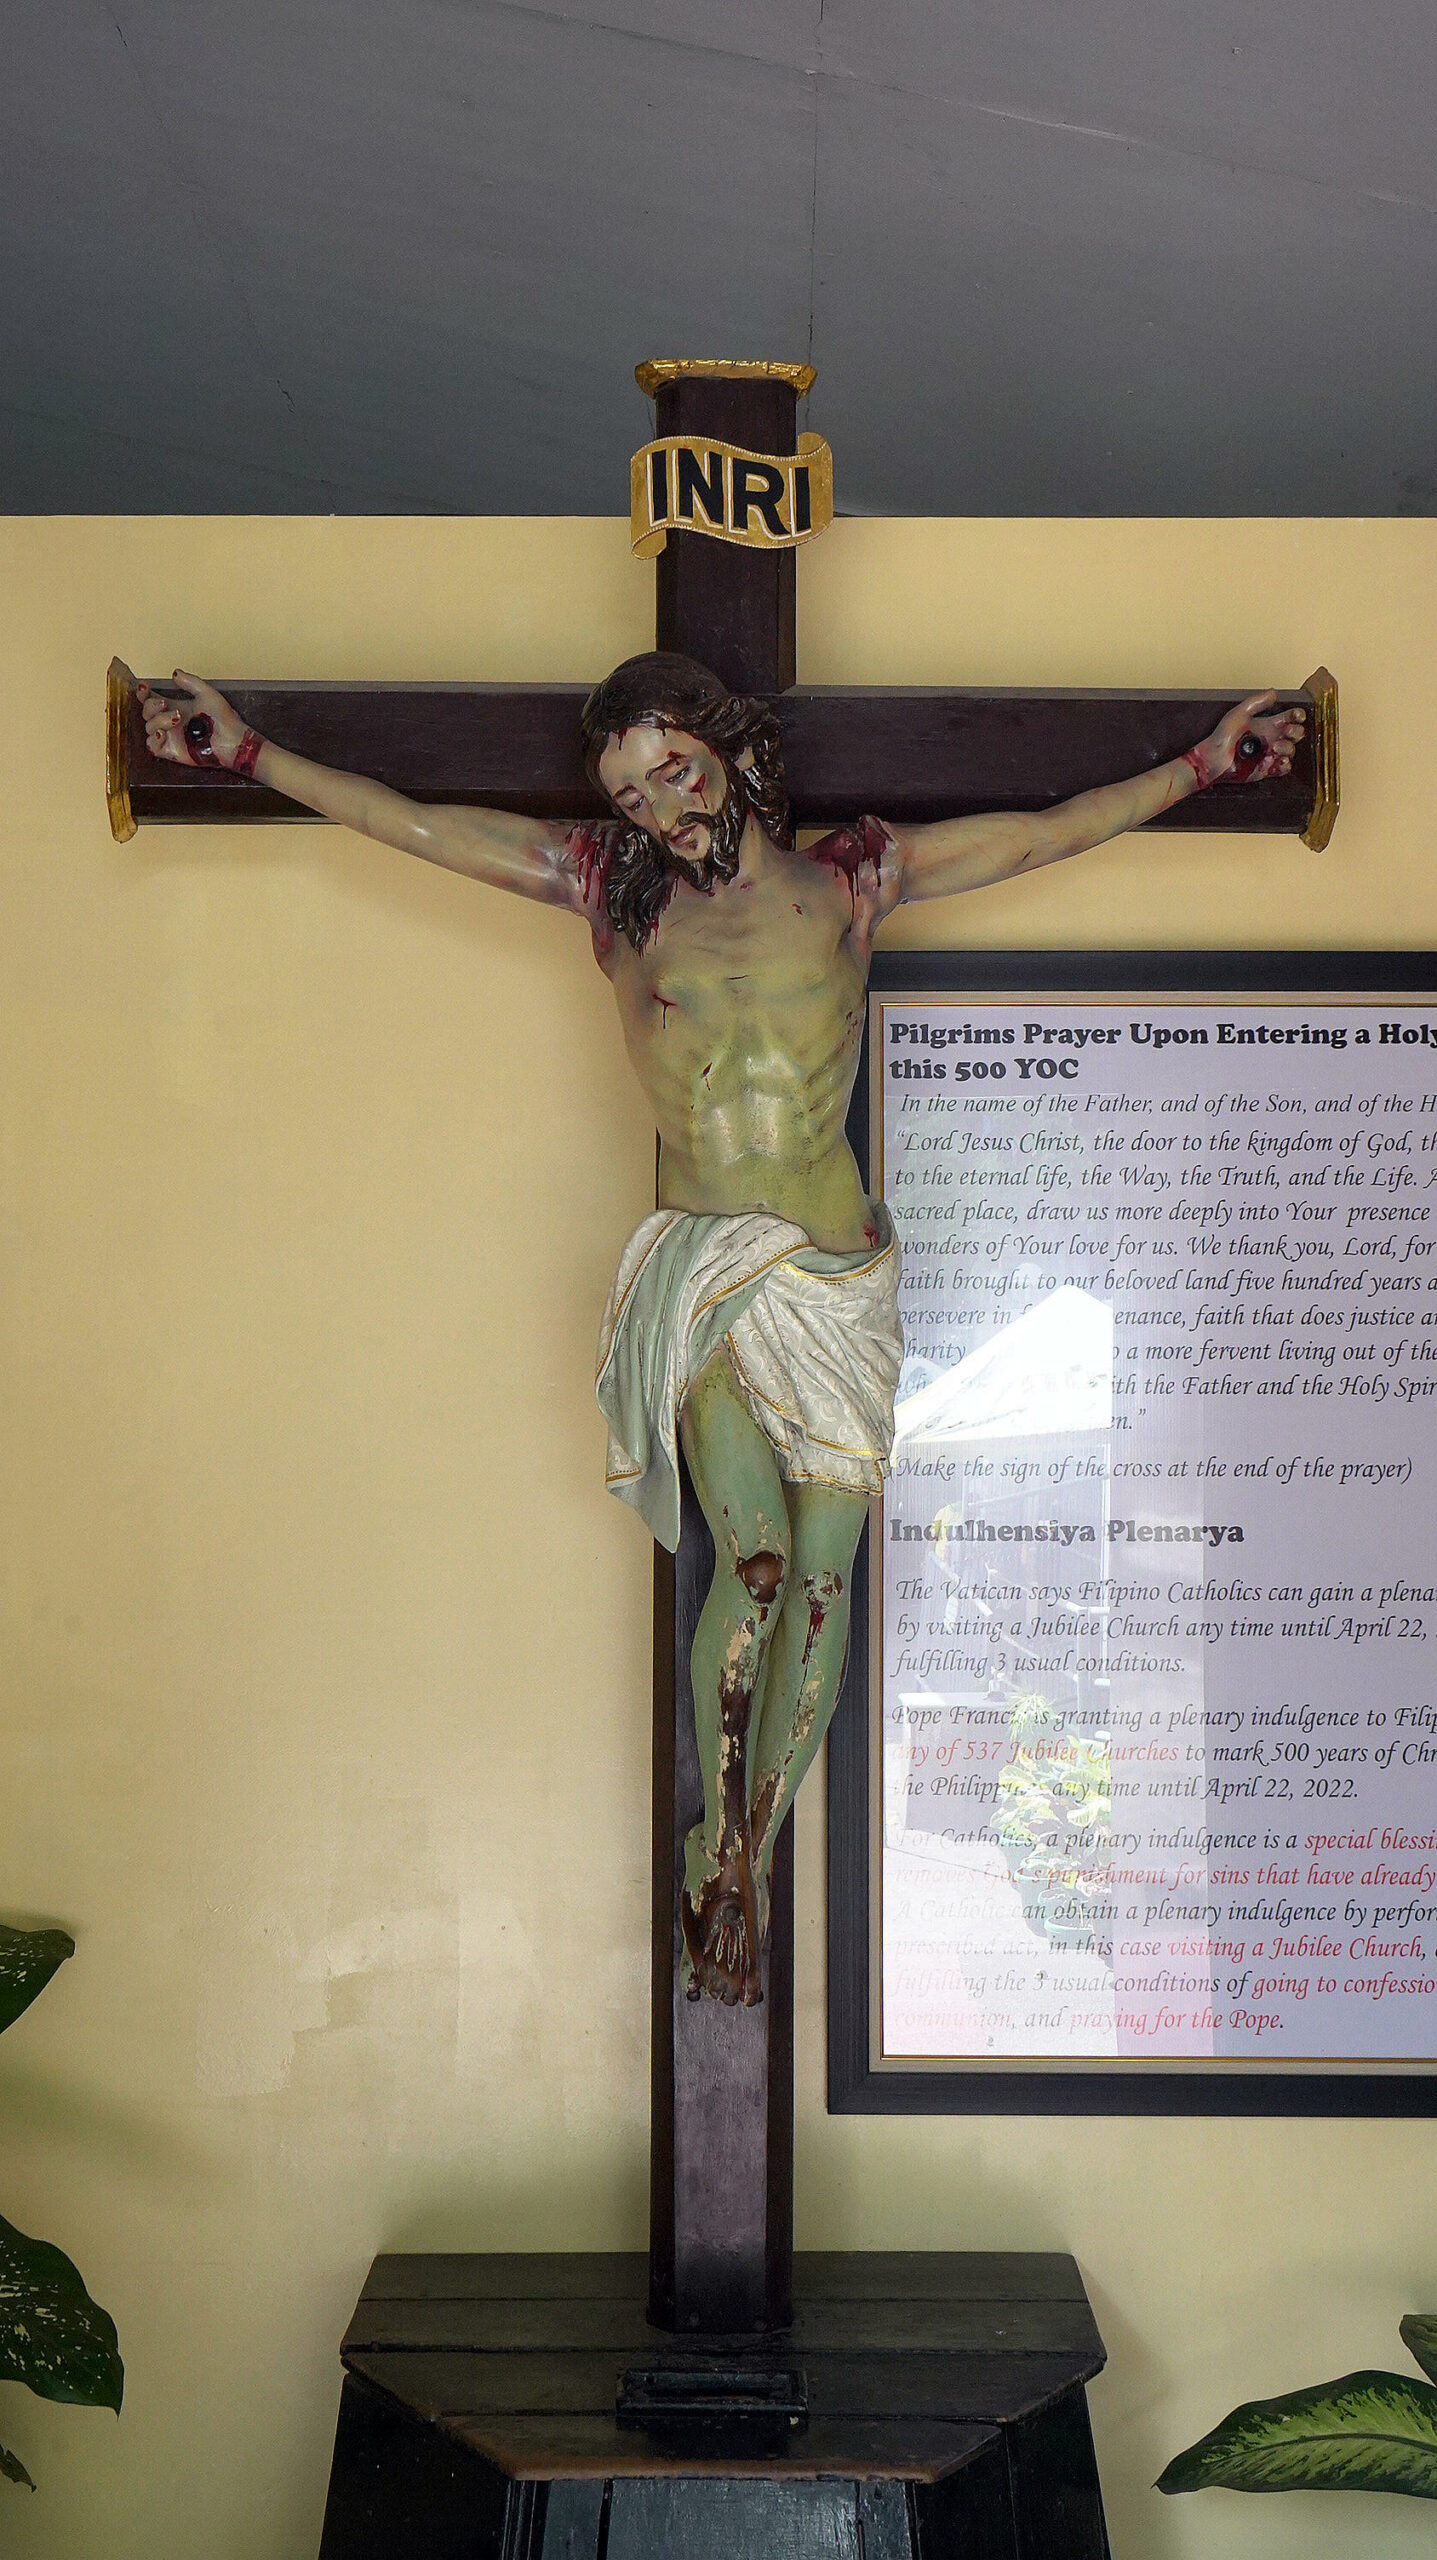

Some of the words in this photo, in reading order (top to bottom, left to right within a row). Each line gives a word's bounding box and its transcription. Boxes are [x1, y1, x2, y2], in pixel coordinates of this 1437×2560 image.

[647, 448, 812, 540] INRI
[889, 1024, 1015, 1049] Pilgrims
[1023, 1024, 1121, 1048] Prayer
[1129, 1024, 1209, 1048] Upon
[1216, 1024, 1347, 1049] Entering
[1355, 1028, 1371, 1044] a
[889, 1059, 947, 1079] this
[955, 1062, 1007, 1081] 500
[1014, 1058, 1079, 1079] YOC
[901, 1094, 920, 1112] In
[927, 1094, 957, 1112] the
[964, 1099, 1017, 1112] name
[1049, 1094, 1078, 1112] the
[1084, 1094, 1153, 1115] Father,
[1161, 1094, 1199, 1112] and
[1230, 1094, 1260, 1112] the
[1266, 1094, 1307, 1114] Son,
[1315, 1094, 1353, 1112] and
[1383, 1094, 1413, 1112] the
[958, 1132, 1013, 1154] Jesus
[1019, 1130, 1084, 1155] Christ,
[1094, 1130, 1124, 1150] the
[1131, 1130, 1177, 1150] door
[1209, 1130, 1240, 1150] the
[1247, 1130, 1333, 1158] kingdom
[1339, 1130, 1364, 1158] of
[1367, 1131, 1413, 1158] God,
[923, 1165, 953, 1185] the
[959, 1165, 1034, 1185] eternal
[1035, 1165, 1072, 1192] life,
[1081, 1165, 1112, 1185] the
[1119, 1165, 1171, 1192] Way,
[1181, 1165, 1212, 1186] the
[1218, 1165, 1280, 1189] Truth,
[1289, 1165, 1335, 1186] and
[1334, 1165, 1364, 1186] the
[1371, 1165, 1417, 1192] Life.
[894, 1199, 962, 1220] sacred
[962, 1200, 1018, 1226] place,
[1027, 1200, 1080, 1220] draw
[1087, 1205, 1108, 1220] us
[1116, 1205, 1162, 1220] more
[1169, 1200, 1233, 1227] deeply
[1239, 1201, 1279, 1221] into
[1286, 1201, 1337, 1221] Your
[1346, 1206, 1430, 1227] presence
[902, 1234, 986, 1255] wonders
[986, 1234, 1011, 1261] of
[1013, 1237, 1064, 1255] Your
[1069, 1234, 1109, 1255] love
[1110, 1234, 1148, 1261] for
[1187, 1234, 1221, 1255] We
[1229, 1234, 1292, 1259] thank
[1290, 1241, 1334, 1262] you,
[1343, 1234, 1397, 1258] Lord,
[1399, 1235, 1436, 1262] for
[952, 1269, 1030, 1296] brought
[1104, 1269, 1183, 1290] beloved
[1185, 1269, 1235, 1290] land
[1230, 1270, 1274, 1296] five
[1281, 1269, 1369, 1290] hundred
[1368, 1276, 1421, 1297] years
[1189, 1304, 1245, 1331] faith
[1252, 1305, 1294, 1325] that
[1301, 1305, 1344, 1325] does
[1346, 1306, 1414, 1332] justice
[1145, 1346, 1192, 1359] more
[1193, 1339, 1271, 1366] fervent
[1278, 1339, 1335, 1367] living
[1343, 1343, 1375, 1360] out
[1383, 1340, 1409, 1366] of
[1144, 1374, 1175, 1395] the
[1183, 1374, 1253, 1395] Father
[1257, 1374, 1300, 1395] and
[1302, 1374, 1333, 1395] the
[1338, 1375, 1389, 1401] Holy
[964, 1456, 995, 1476] the
[1000, 1457, 1041, 1482] sign
[1048, 1456, 1073, 1483] of
[1075, 1456, 1106, 1476] the
[1113, 1462, 1162, 1476] cross
[1167, 1460, 1188, 1477] at
[1196, 1456, 1227, 1477] the
[1234, 1456, 1273, 1477] end
[1276, 1456, 1302, 1484] of
[1303, 1456, 1334, 1477] the
[1339, 1457, 1412, 1484] prayer)
[890, 1519, 1096, 1546] Indulhensiya
[1106, 1519, 1244, 1547] Plenarya
[896, 1578, 933, 1600] The
[940, 1579, 1021, 1600] Vatican
[1028, 1585, 1071, 1606] says
[1078, 1579, 1160, 1607] Filipino
[1168, 1579, 1262, 1603] Catholics
[1268, 1587, 1302, 1601] can
[1307, 1582, 1354, 1608] gain
[897, 1614, 919, 1636] by
[927, 1616, 1003, 1642] visiting
[1027, 1614, 1099, 1639] Jubilee
[1107, 1615, 1179, 1638] Church
[1186, 1622, 1223, 1643] any
[1230, 1617, 1273, 1637] time
[1281, 1615, 1335, 1637] until
[1334, 1616, 1395, 1643] April
[1397, 1619, 1427, 1640] 22,
[890, 1650, 988, 1678] fulfilling
[1014, 1650, 1073, 1671] usual
[1076, 1650, 1185, 1671] conditions.
[892, 1705, 941, 1731] Pope
[1054, 1705, 1142, 1732] granting
[1167, 1704, 1244, 1732] plenary
[1251, 1704, 1359, 1733] indulgence
[1367, 1709, 1386, 1726] to
[936, 1738, 964, 1766] of
[963, 1742, 1003, 1760] 537
[1007, 1740, 1078, 1764] Jubilee
[1186, 1744, 1205, 1761] to
[1213, 1740, 1269, 1766] mark
[1270, 1743, 1310, 1762] 500
[1313, 1747, 1368, 1768] years
[1374, 1741, 1400, 1769] of
[1097, 1776, 1140, 1796] time
[1148, 1776, 1202, 1797] until
[1203, 1776, 1262, 1804] April
[1264, 1779, 1293, 1801] 22,
[1303, 1779, 1358, 1798] 2022.
[1149, 1827, 1256, 1855] indulgence
[1264, 1829, 1280, 1848] is
[1304, 1828, 1378, 1855] special
[1169, 1863, 1206, 1891] for
[1210, 1865, 1249, 1885] sins
[1257, 1863, 1299, 1886] that
[1307, 1863, 1354, 1886] have
[1361, 1864, 1436, 1892] already
[1143, 1898, 1221, 1926] plenary
[1228, 1899, 1336, 1927] indulgence
[1344, 1899, 1367, 1927] by
[1076, 1934, 1113, 1955] this
[1120, 1941, 1161, 1955] case
[1168, 1936, 1245, 1963] visiting
[1269, 1935, 1342, 1959] Jubilee
[1349, 1936, 1426, 1960] Church,
[1052, 1970, 1113, 1990] usual
[1115, 1970, 1219, 1993] conditions
[1226, 1971, 1252, 1999] of
[1252, 1973, 1309, 2000] going
[1317, 1976, 1336, 1993] to
[1149, 2006, 1187, 2035] for
[1192, 2006, 1222, 2028] the
[1229, 2010, 1283, 2035] Pope.
